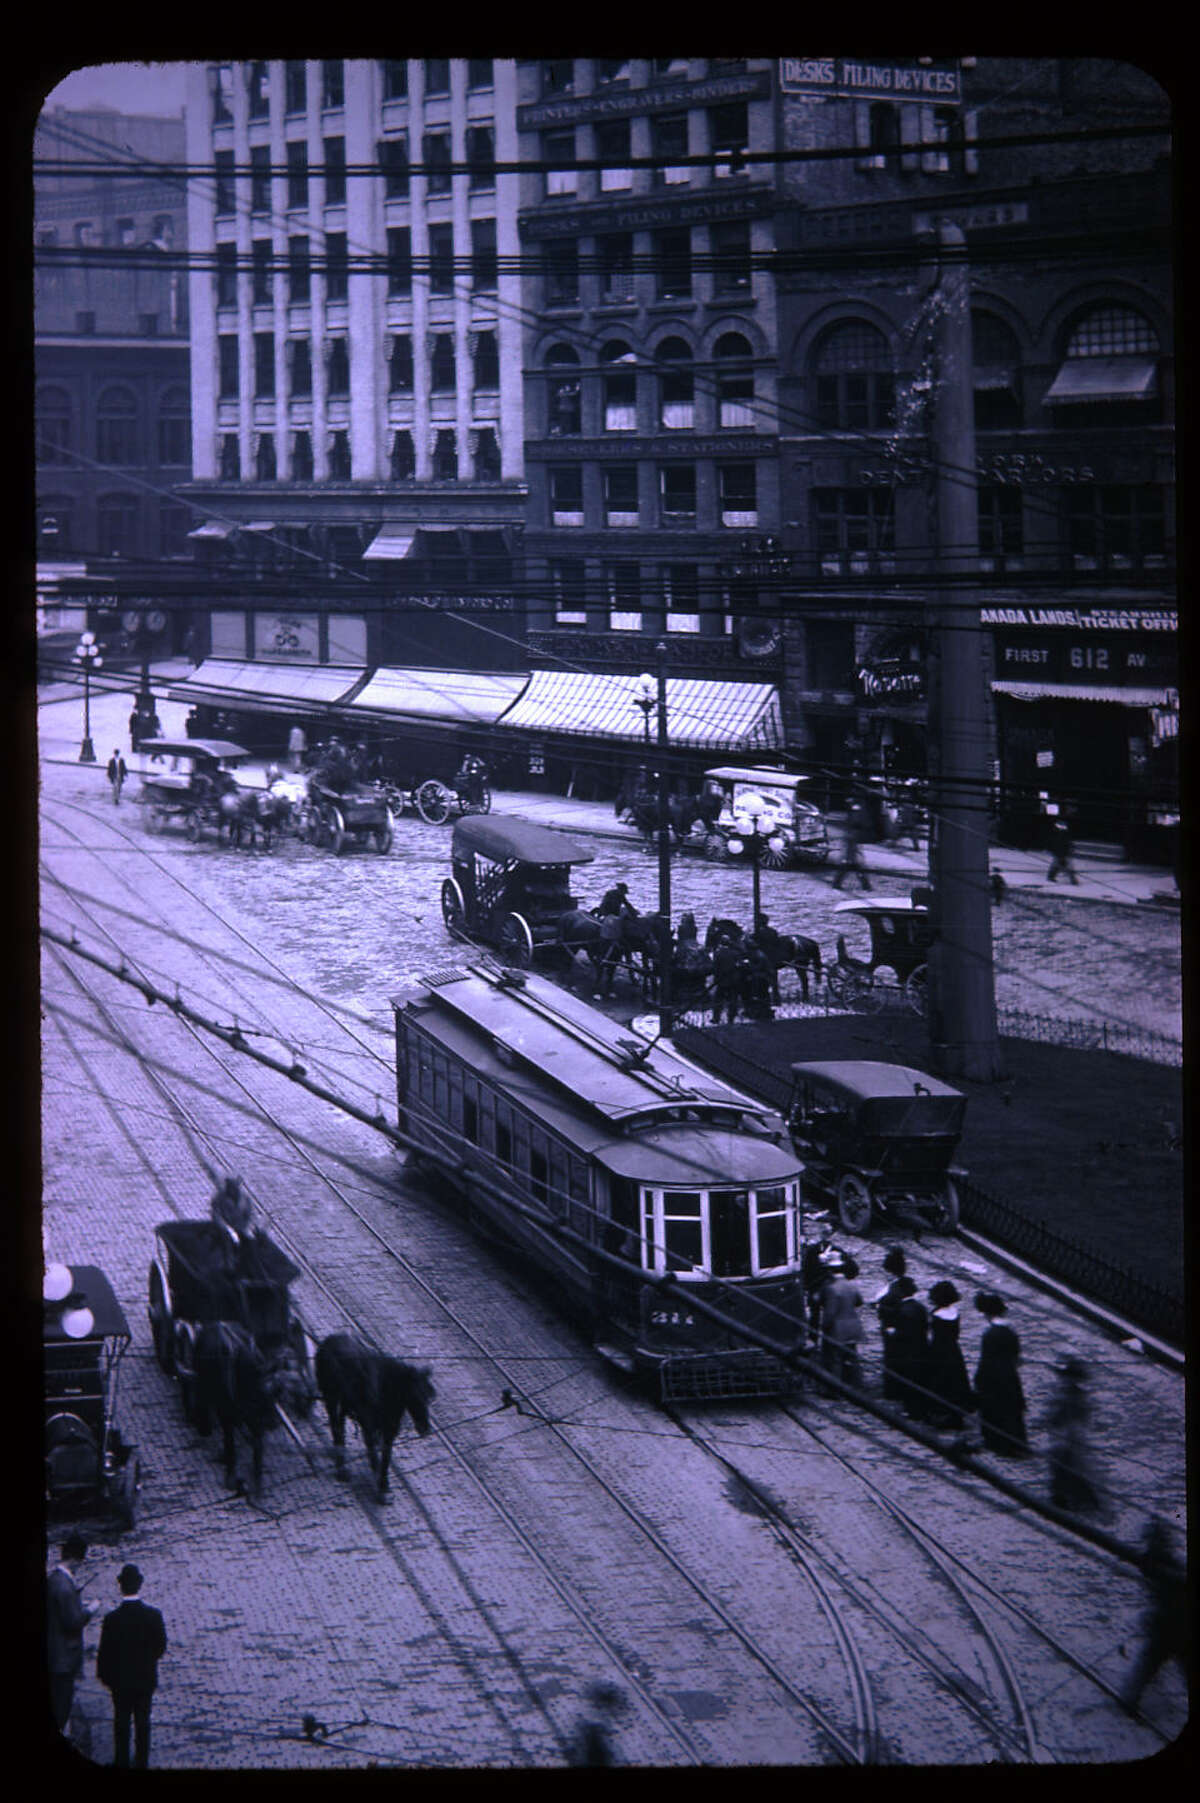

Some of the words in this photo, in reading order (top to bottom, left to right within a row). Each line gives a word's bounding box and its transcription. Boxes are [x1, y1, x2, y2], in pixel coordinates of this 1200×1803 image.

[894, 68, 956, 93] DEVICES
[979, 608, 1028, 625] ANADA
[1081, 617, 1137, 630] TICKET
[1141, 618, 1178, 632] OFFI
[1004, 648, 1048, 663] FIRST
[1070, 647, 1109, 669] 612
